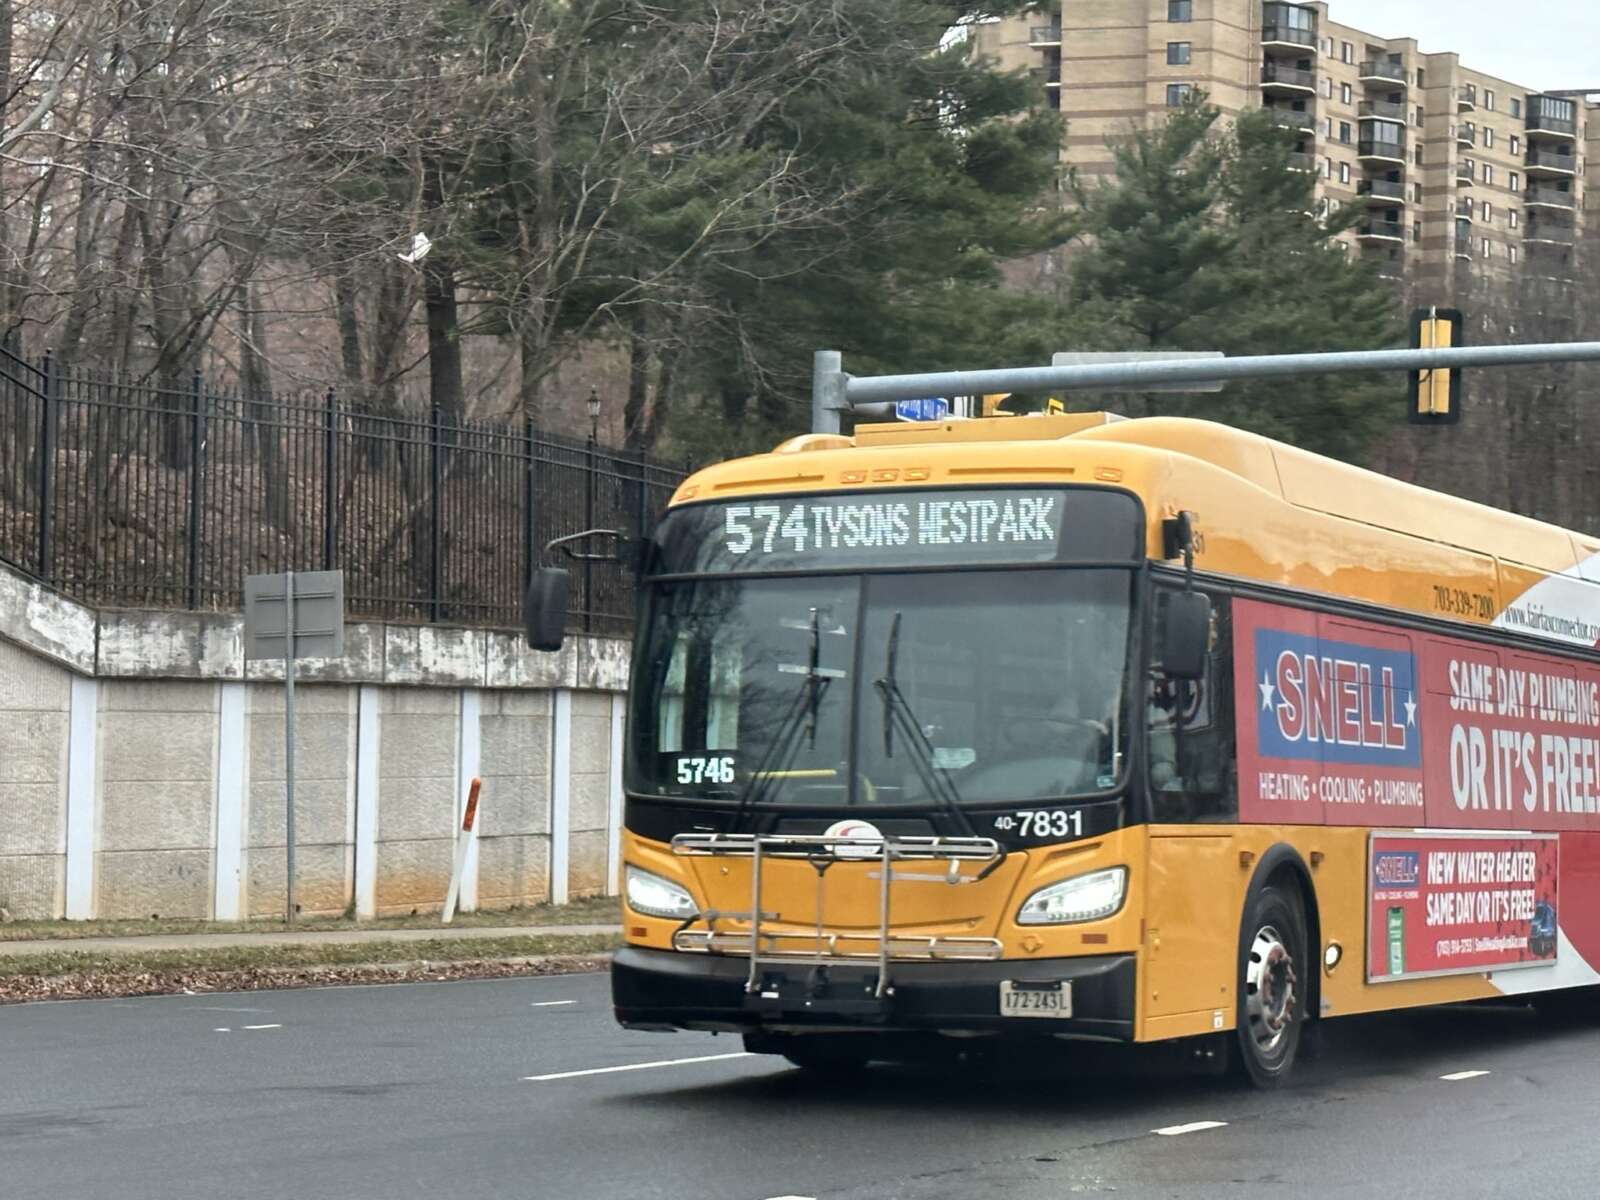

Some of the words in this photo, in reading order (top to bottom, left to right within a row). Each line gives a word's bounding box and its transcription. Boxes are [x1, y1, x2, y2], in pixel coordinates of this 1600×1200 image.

[726, 505, 808, 553] 574
[811, 503, 909, 548] TYSONS
[918, 497, 1054, 545] WESTPARK
[1276, 650, 1406, 749] SNELL
[1449, 659, 1494, 714] SAME
[1496, 667, 1525, 718] DAY
[1529, 672, 1599, 727] PLUMBING
[677, 757, 735, 784] 5746
[1451, 724, 1488, 810] OR
[1492, 729, 1537, 812] IT'S
[1259, 772, 1310, 800] HEATING
[1319, 776, 1365, 804] COOLING
[1374, 779, 1423, 807] PLUMBING
[1378, 856, 1415, 883] SNELL
[1427, 852, 1456, 885] NEW
[1458, 852, 1494, 884] WATER
[1496, 852, 1536, 882] HEATER
[1426, 893, 1455, 926] SAME
[1456, 892, 1477, 924] DAY
[1477, 891, 1491, 922] OR
[1491, 890, 1509, 922] IT'S
